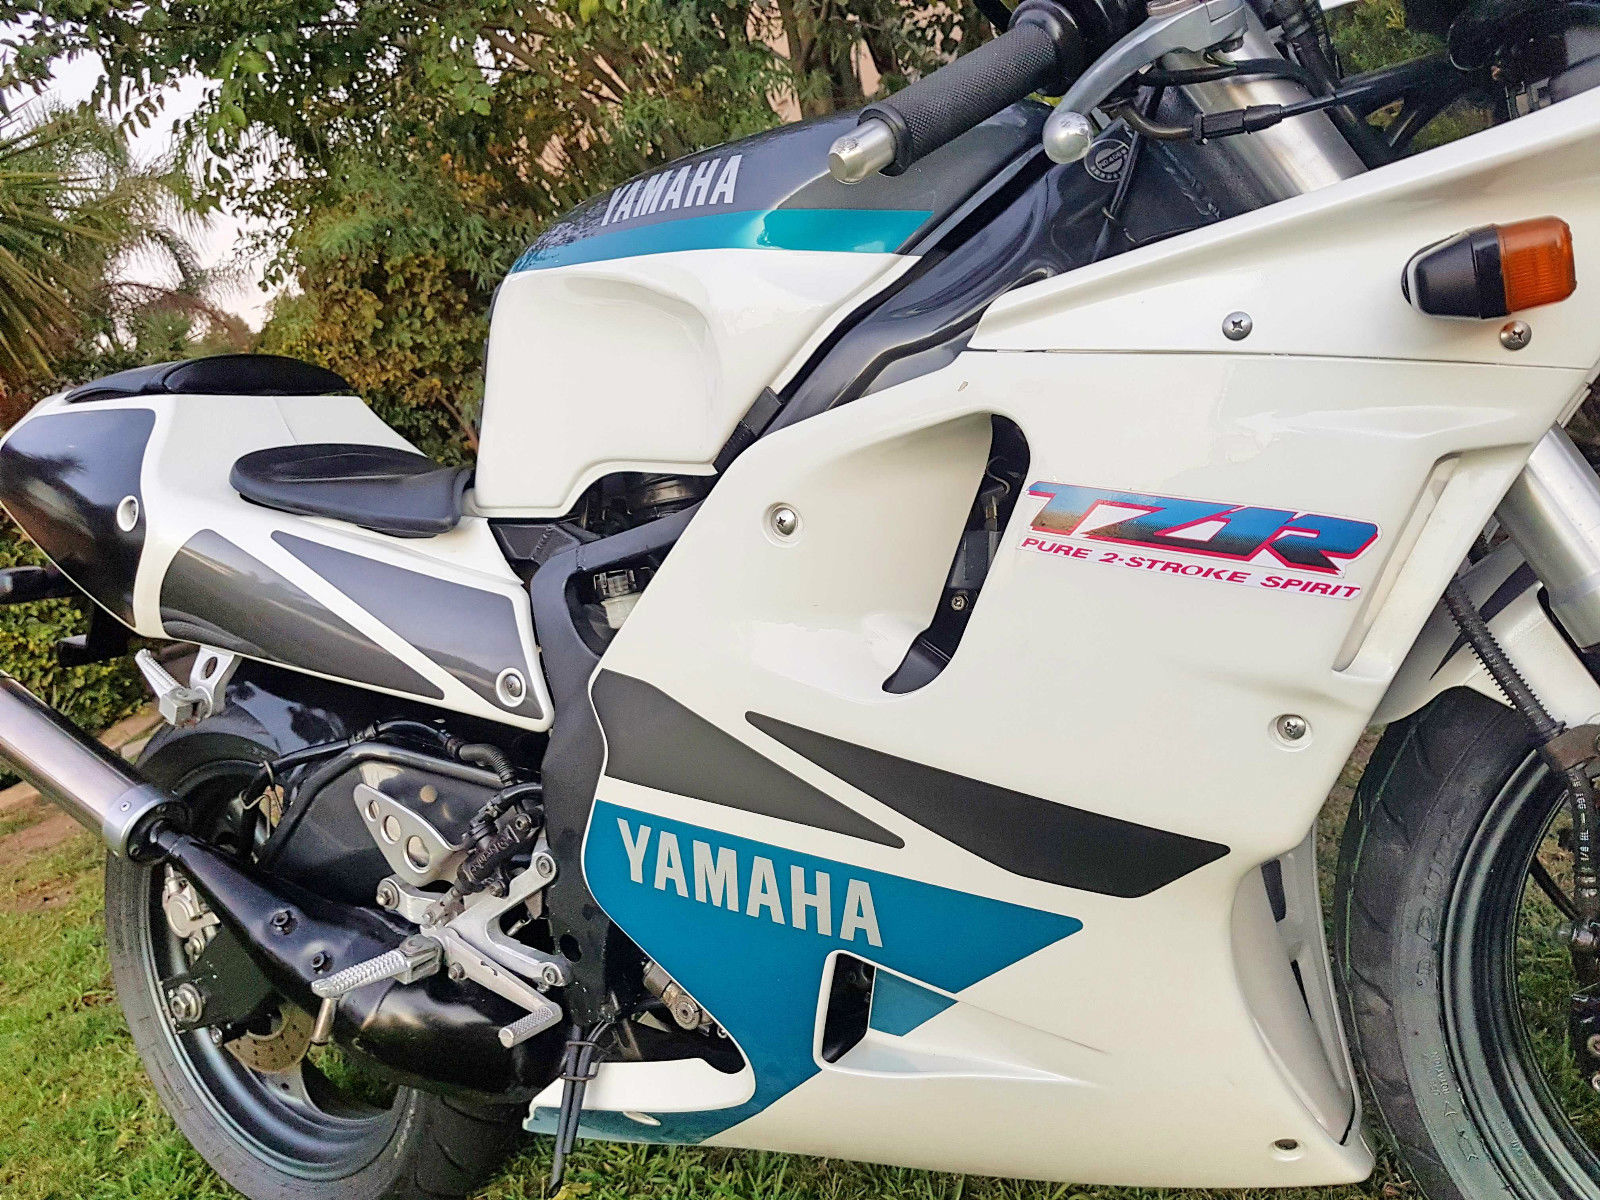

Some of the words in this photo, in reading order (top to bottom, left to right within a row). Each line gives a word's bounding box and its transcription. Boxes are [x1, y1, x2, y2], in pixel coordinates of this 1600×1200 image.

[601, 154, 742, 226] YAMAHA
[1021, 537, 1093, 560] PURE
[1098, 552, 1252, 584] 2-STROKE
[1260, 576, 1361, 599] SPIRIT
[1026, 480, 1379, 575] TZR
[616, 817, 883, 948] YAMAHA
